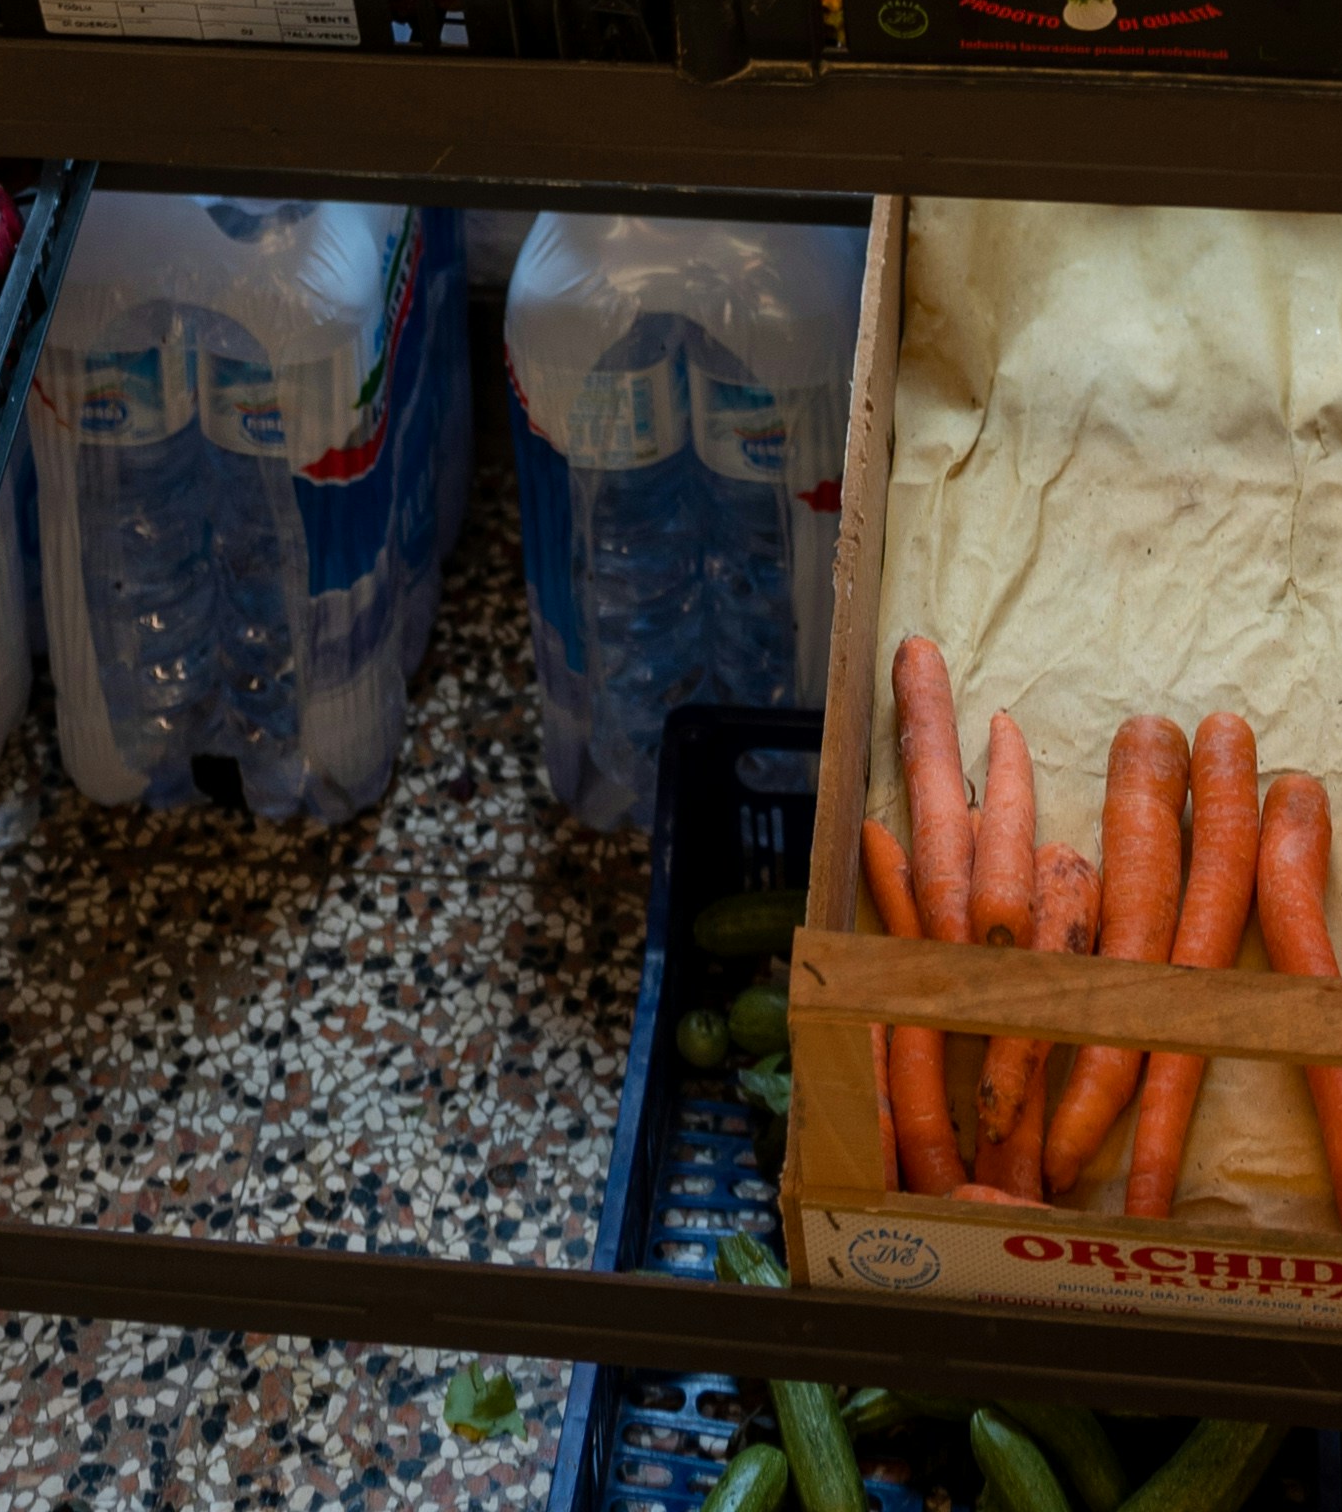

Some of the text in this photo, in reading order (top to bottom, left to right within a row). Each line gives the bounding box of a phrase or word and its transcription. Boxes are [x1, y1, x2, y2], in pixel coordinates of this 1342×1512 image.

[1118, 16, 1139, 32] DI
[857, 1228, 924, 1247] ITALIA
[1101, 1303, 1141, 1316] UVA
